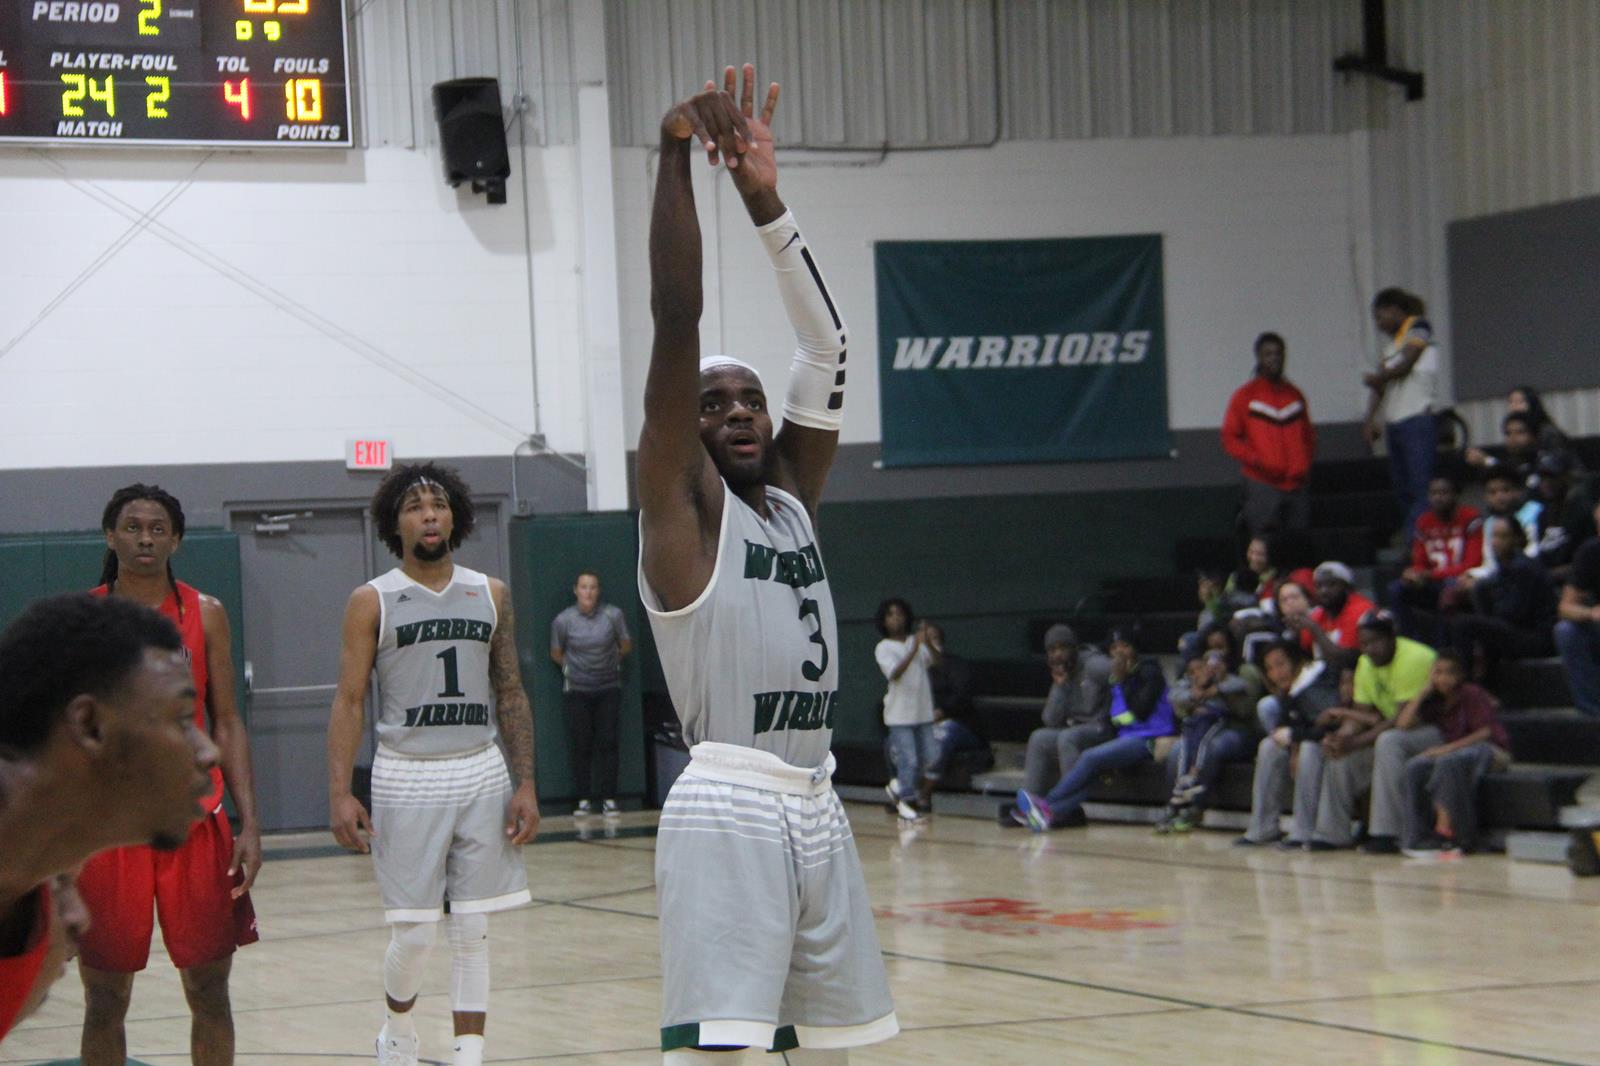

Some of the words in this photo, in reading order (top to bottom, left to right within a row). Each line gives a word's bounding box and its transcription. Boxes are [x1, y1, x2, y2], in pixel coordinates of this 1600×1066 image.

[32, 1, 120, 24] PERIOD
[137, 0, 162, 36] 2
[50, 52, 178, 72] PLAYER-FOUL
[216, 56, 250, 72] TOL
[273, 57, 330, 74] FOULS
[60, 73, 115, 118] 24
[145, 75, 170, 119] 2
[223, 77, 250, 121] 4
[285, 78, 322, 121] 10
[56, 121, 123, 137] MATCH
[276, 124, 341, 140] POINTS
[892, 330, 1152, 370] WARRIORS
[355, 440, 386, 466] EXIT
[394, 617, 493, 649] WEBBER
[798, 597, 829, 682] 3
[435, 645, 465, 698] 1
